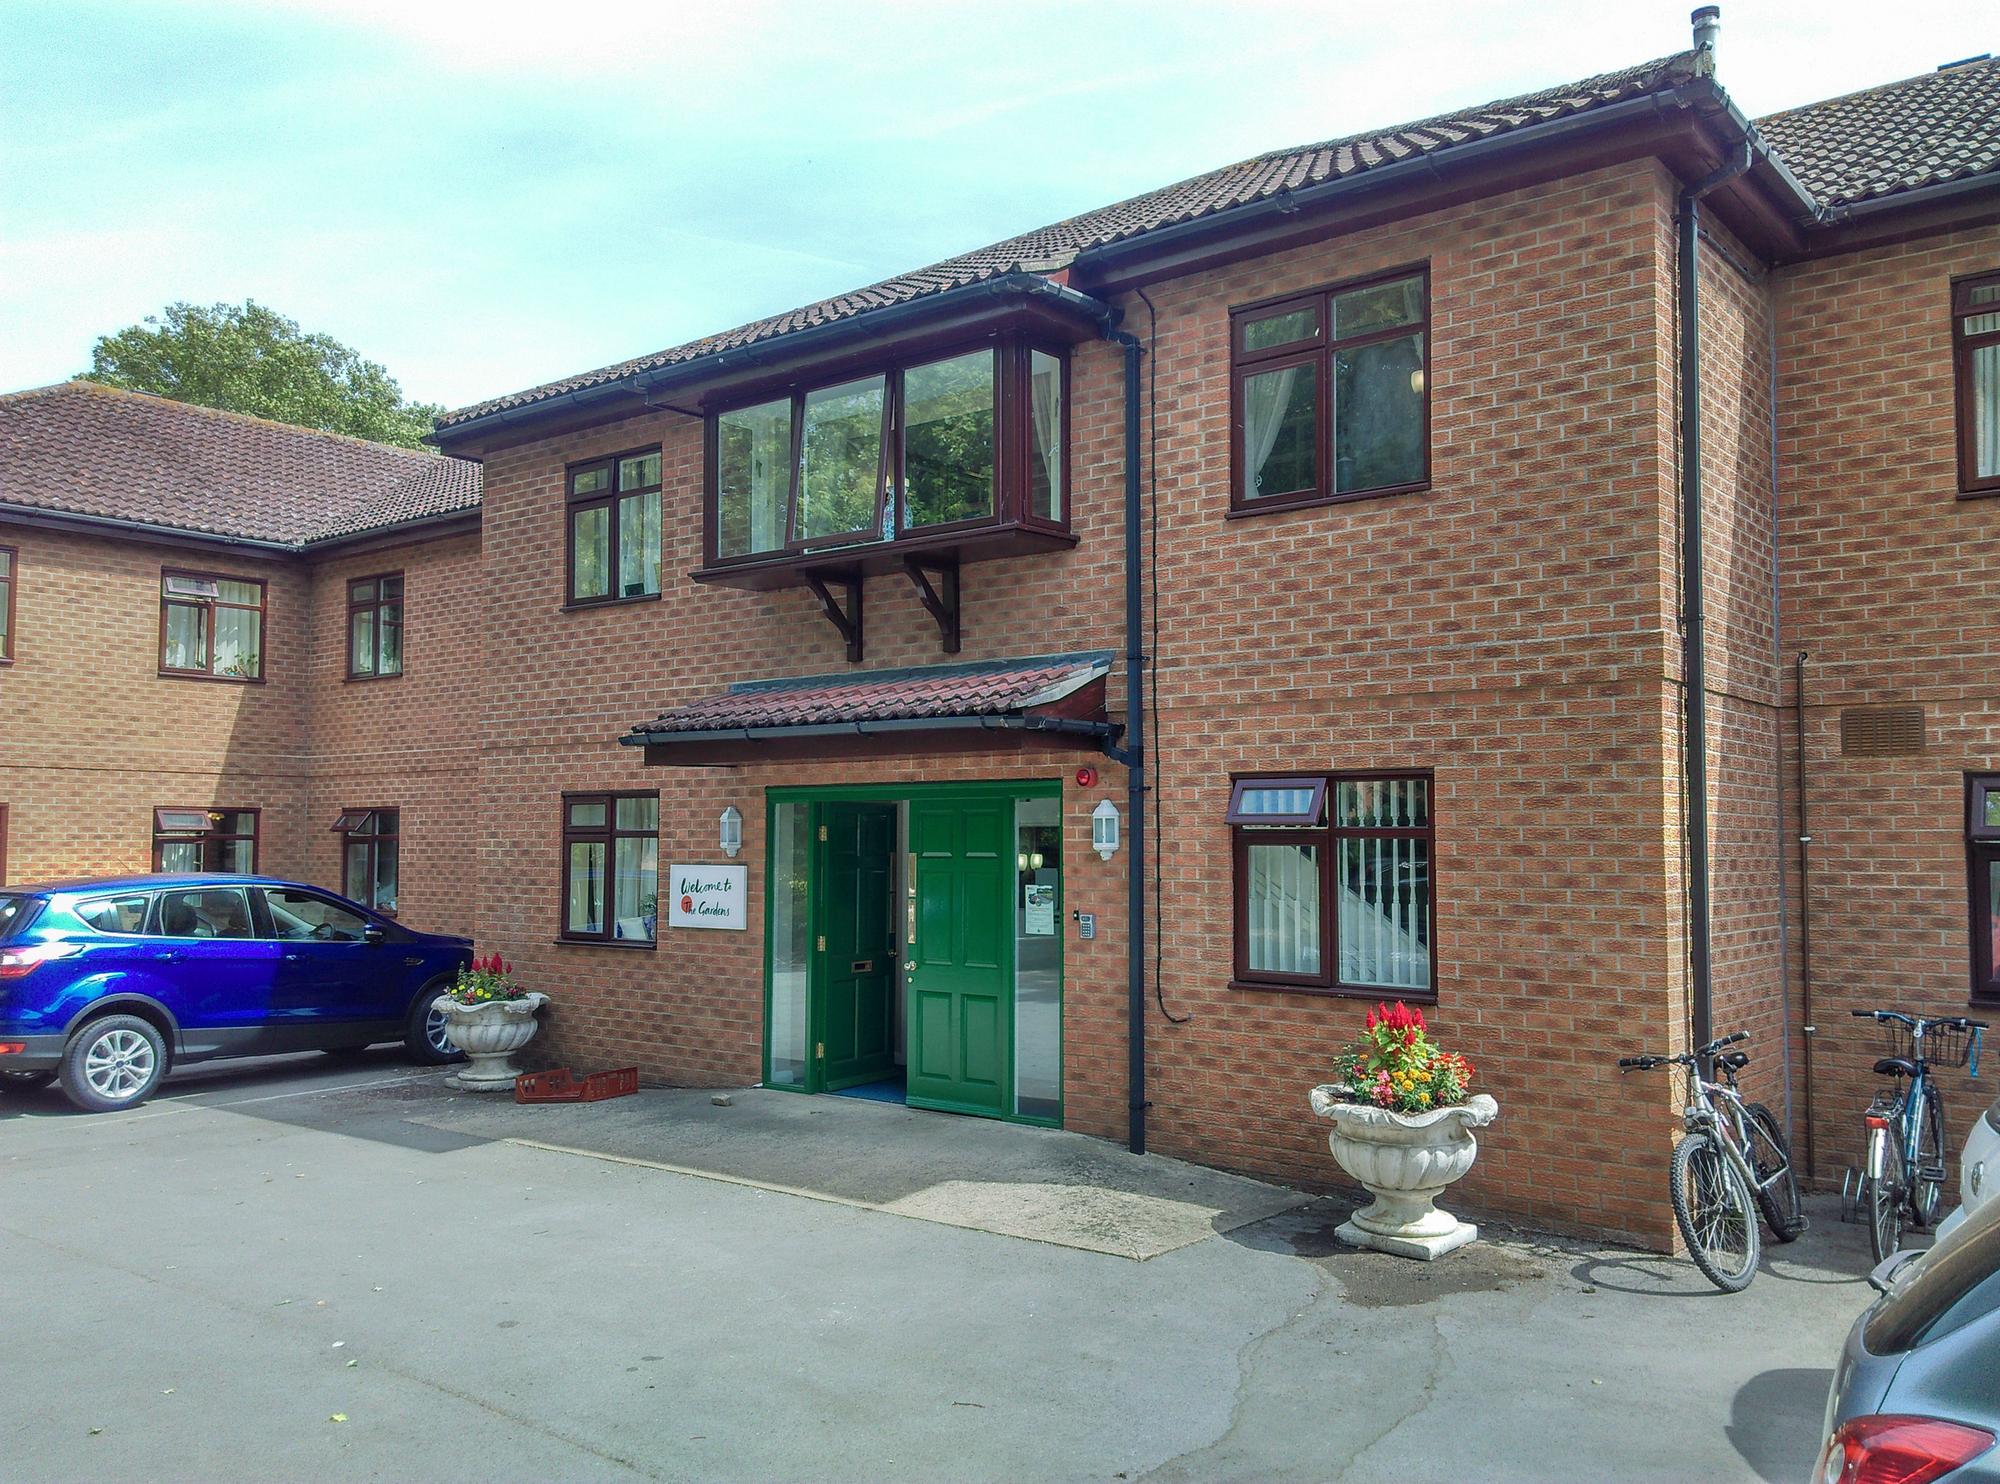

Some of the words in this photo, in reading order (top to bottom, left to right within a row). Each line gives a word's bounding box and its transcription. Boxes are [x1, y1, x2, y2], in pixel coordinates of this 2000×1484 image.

[681, 878, 723, 895] Welcome
[724, 878, 732, 892] to
[698, 901, 730, 916] Gardens
